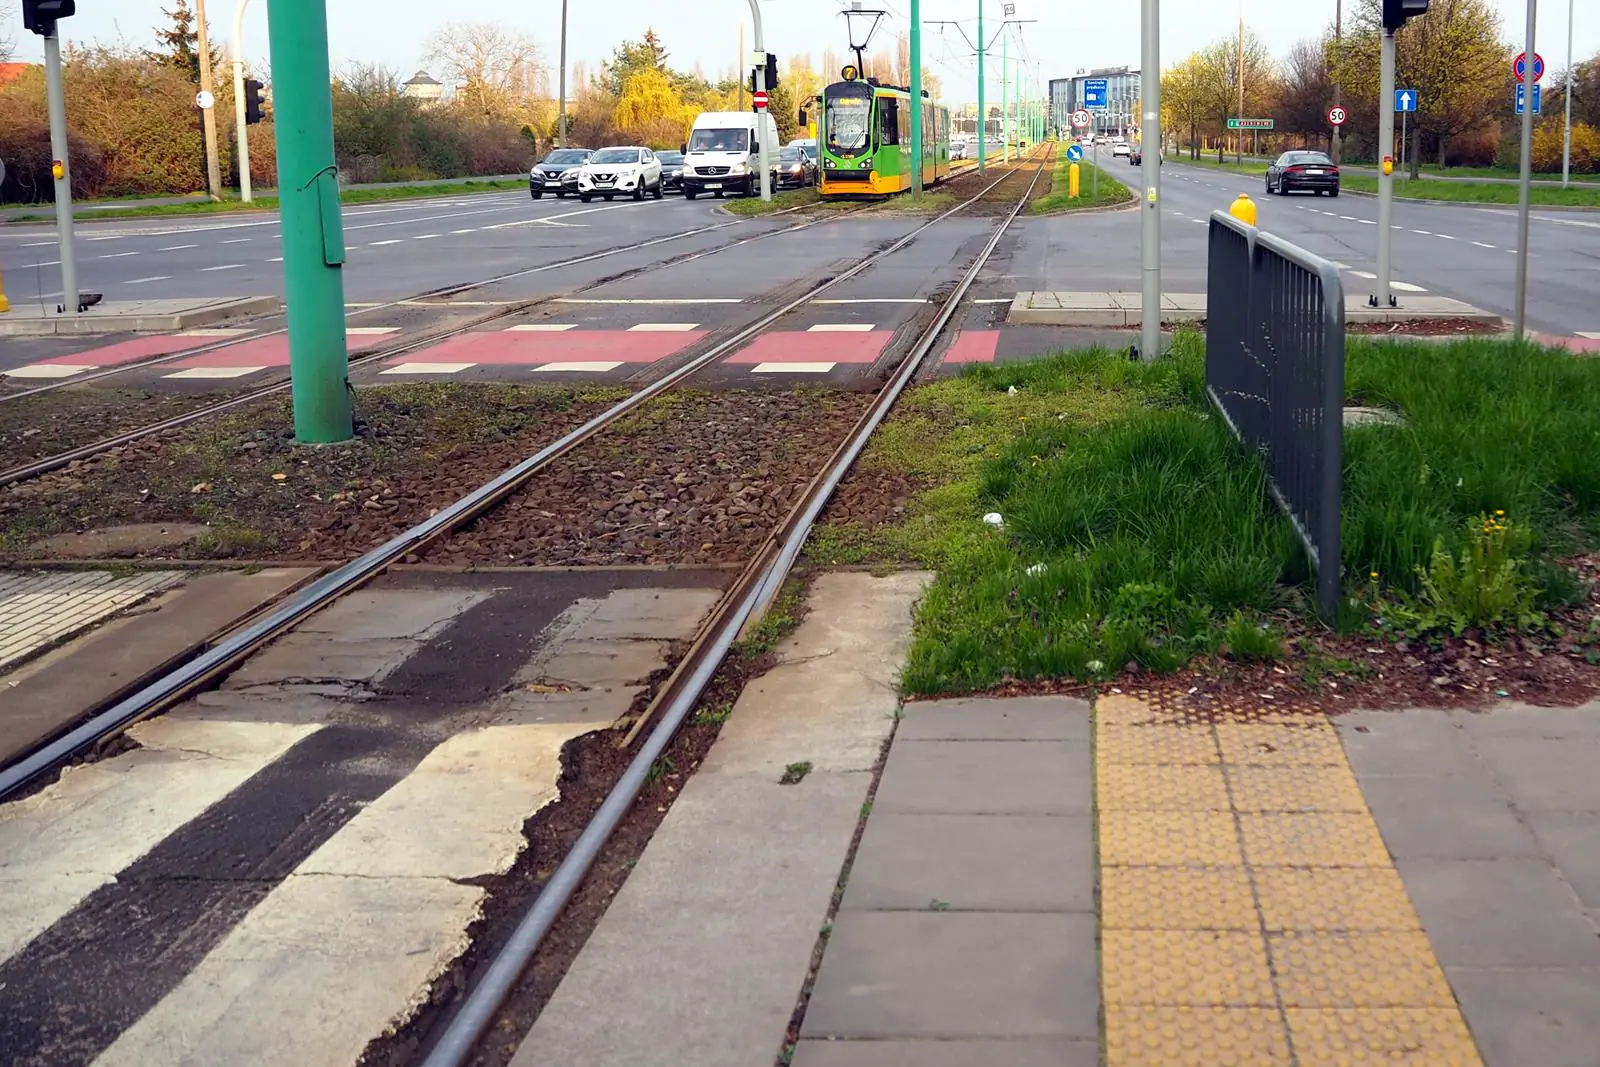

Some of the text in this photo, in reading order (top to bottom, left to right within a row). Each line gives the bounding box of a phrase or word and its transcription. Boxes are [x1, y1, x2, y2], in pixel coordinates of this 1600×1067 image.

[846, 67, 853, 79] 7
[1075, 114, 1088, 123] 50
[1331, 111, 1344, 121] 50
